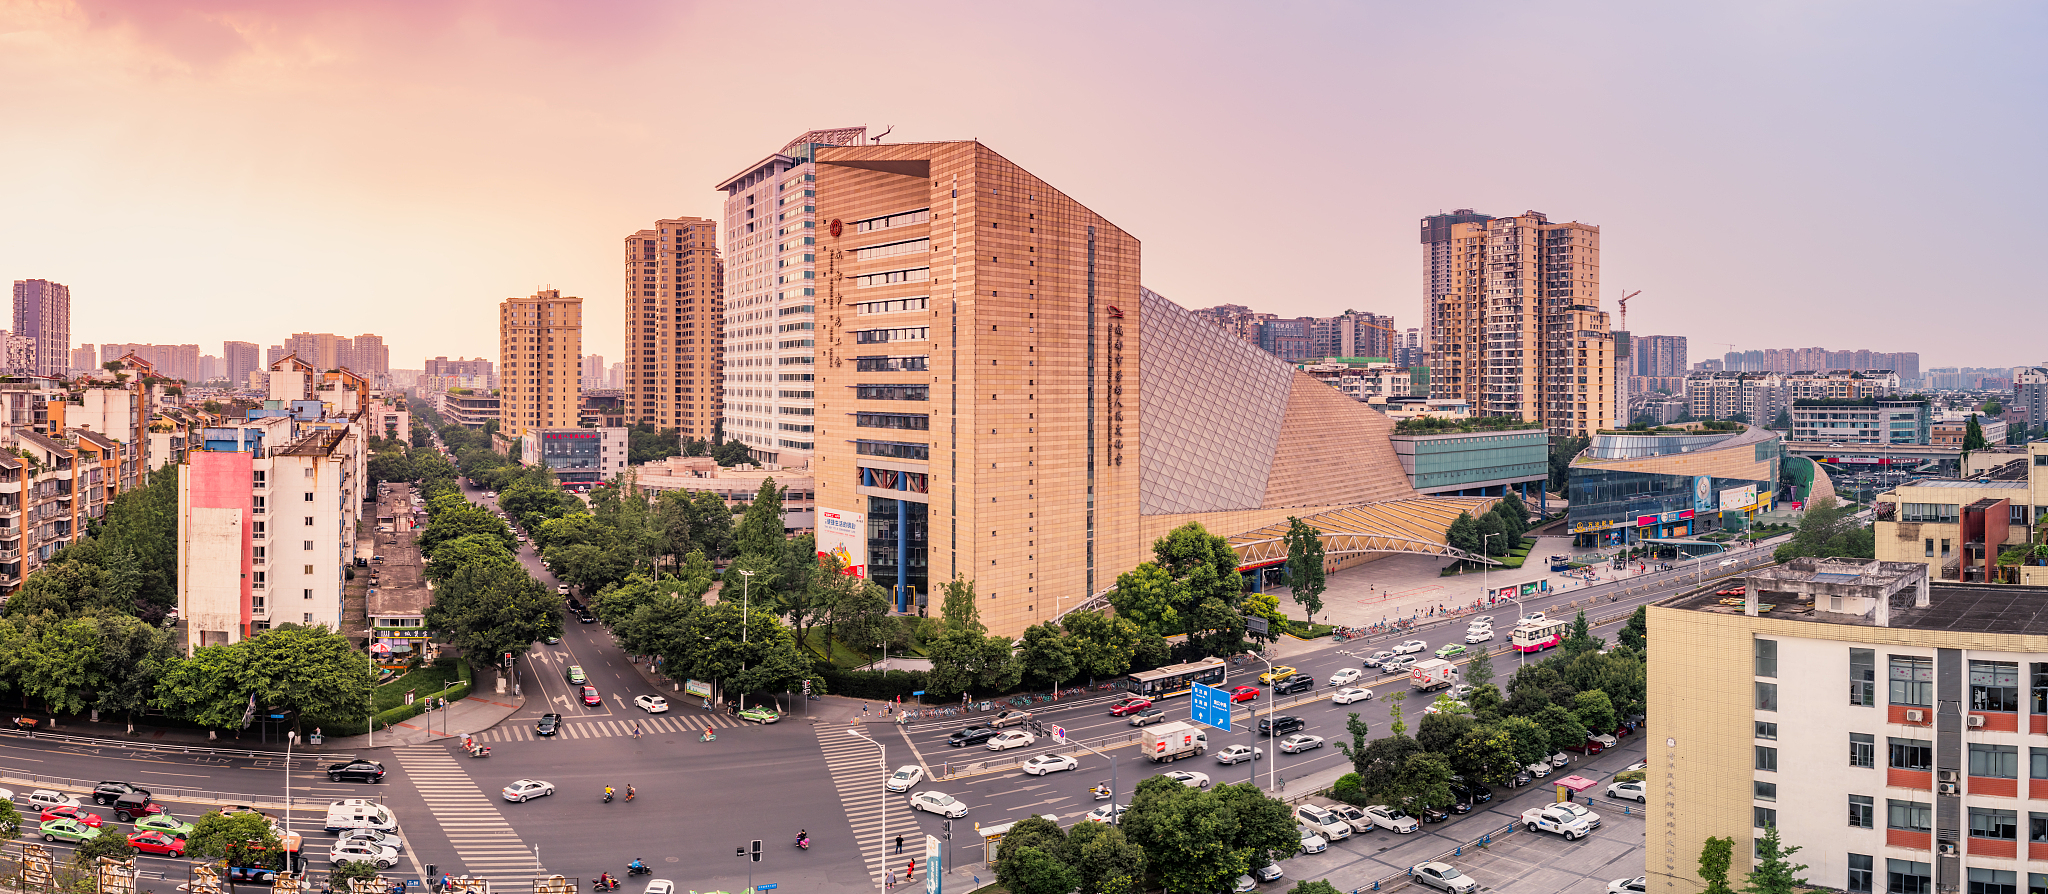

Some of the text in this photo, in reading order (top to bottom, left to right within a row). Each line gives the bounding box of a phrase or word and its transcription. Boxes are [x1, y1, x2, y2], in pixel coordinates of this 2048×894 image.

[1114, 322, 1124, 467] 成都市劳动人民文化宫
[1587, 519, 1614, 528] 万达影城
